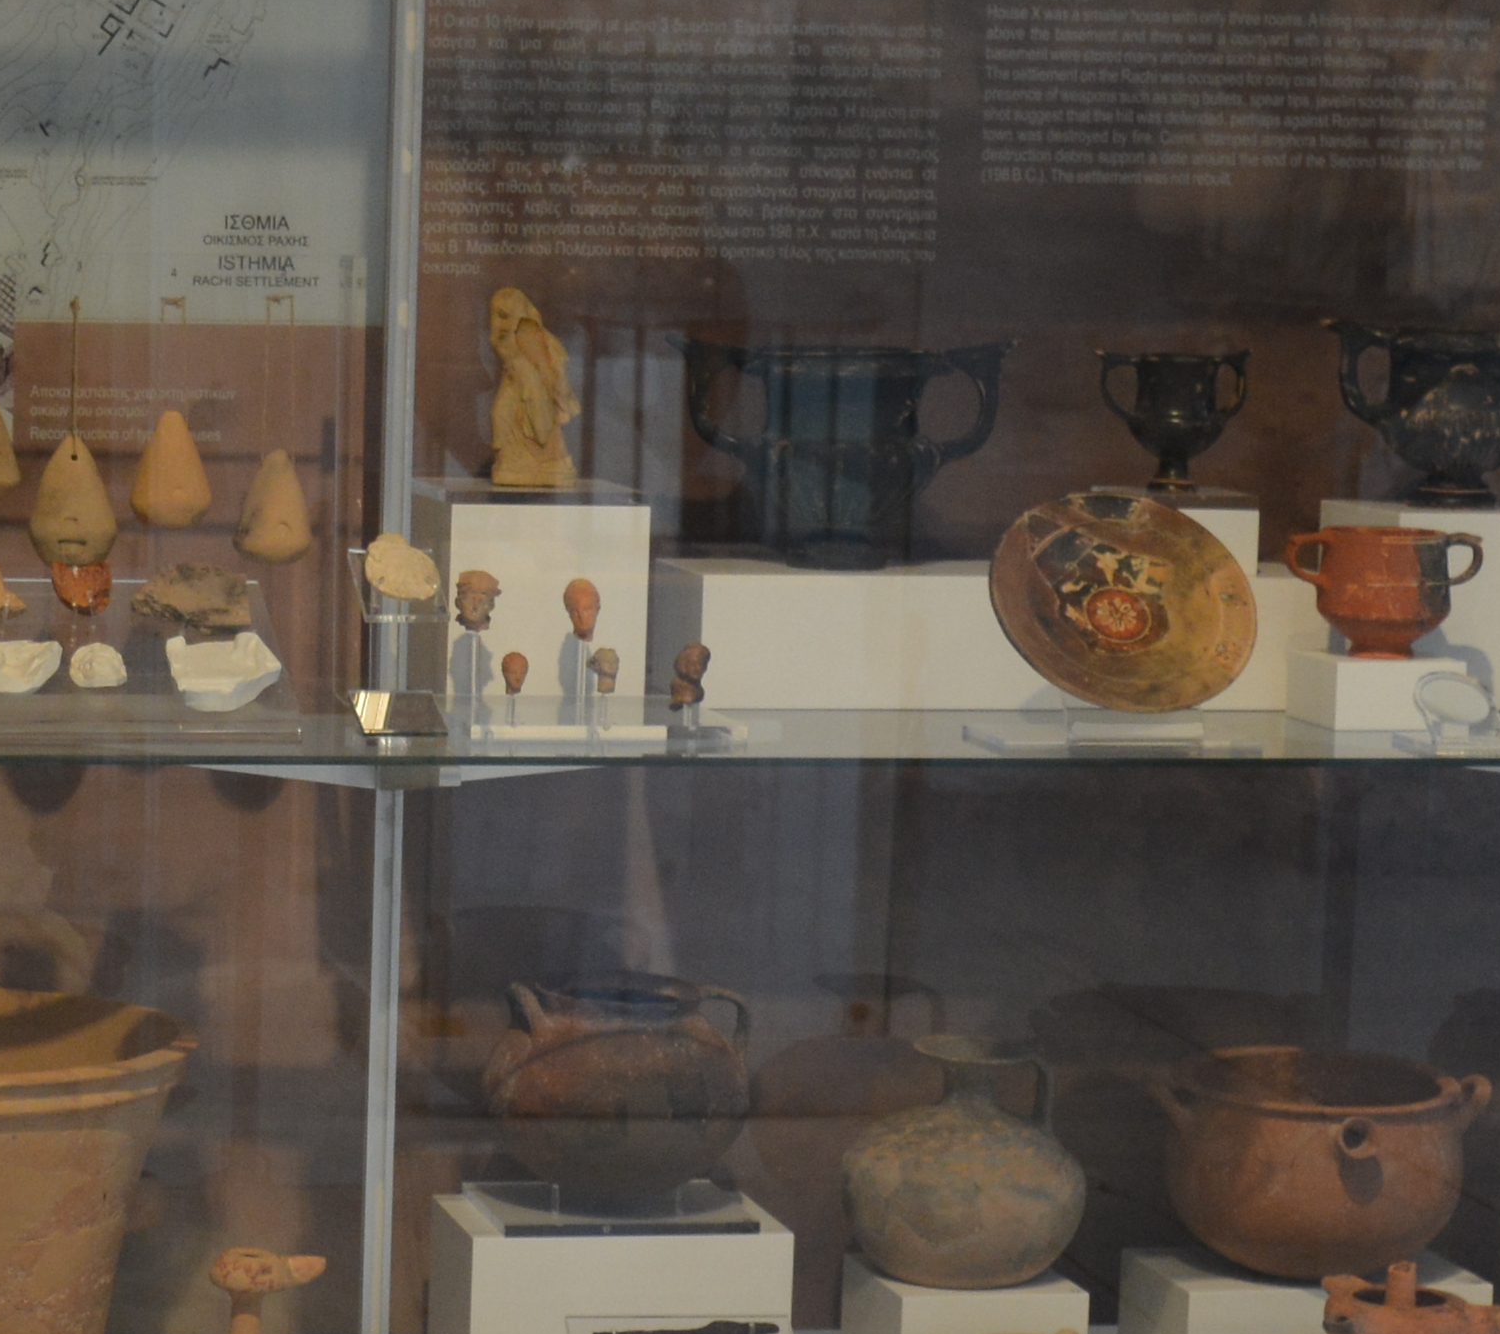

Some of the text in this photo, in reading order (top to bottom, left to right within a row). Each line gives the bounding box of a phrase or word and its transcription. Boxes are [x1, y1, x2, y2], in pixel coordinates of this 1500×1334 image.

[1051, 167, 1074, 183] The
[1076, 168, 1142, 184] settlement
[1144, 172, 1168, 184] was
[224, 214, 290, 231] ΙΣΘΜΙΑ
[202, 234, 309, 247] ΟΙΚΙΣΜΟΣ ΡΑΧΗΣ
[218, 254, 295, 271] ISTHMIA
[192, 275, 320, 288] RACHI SETTLEMENT
